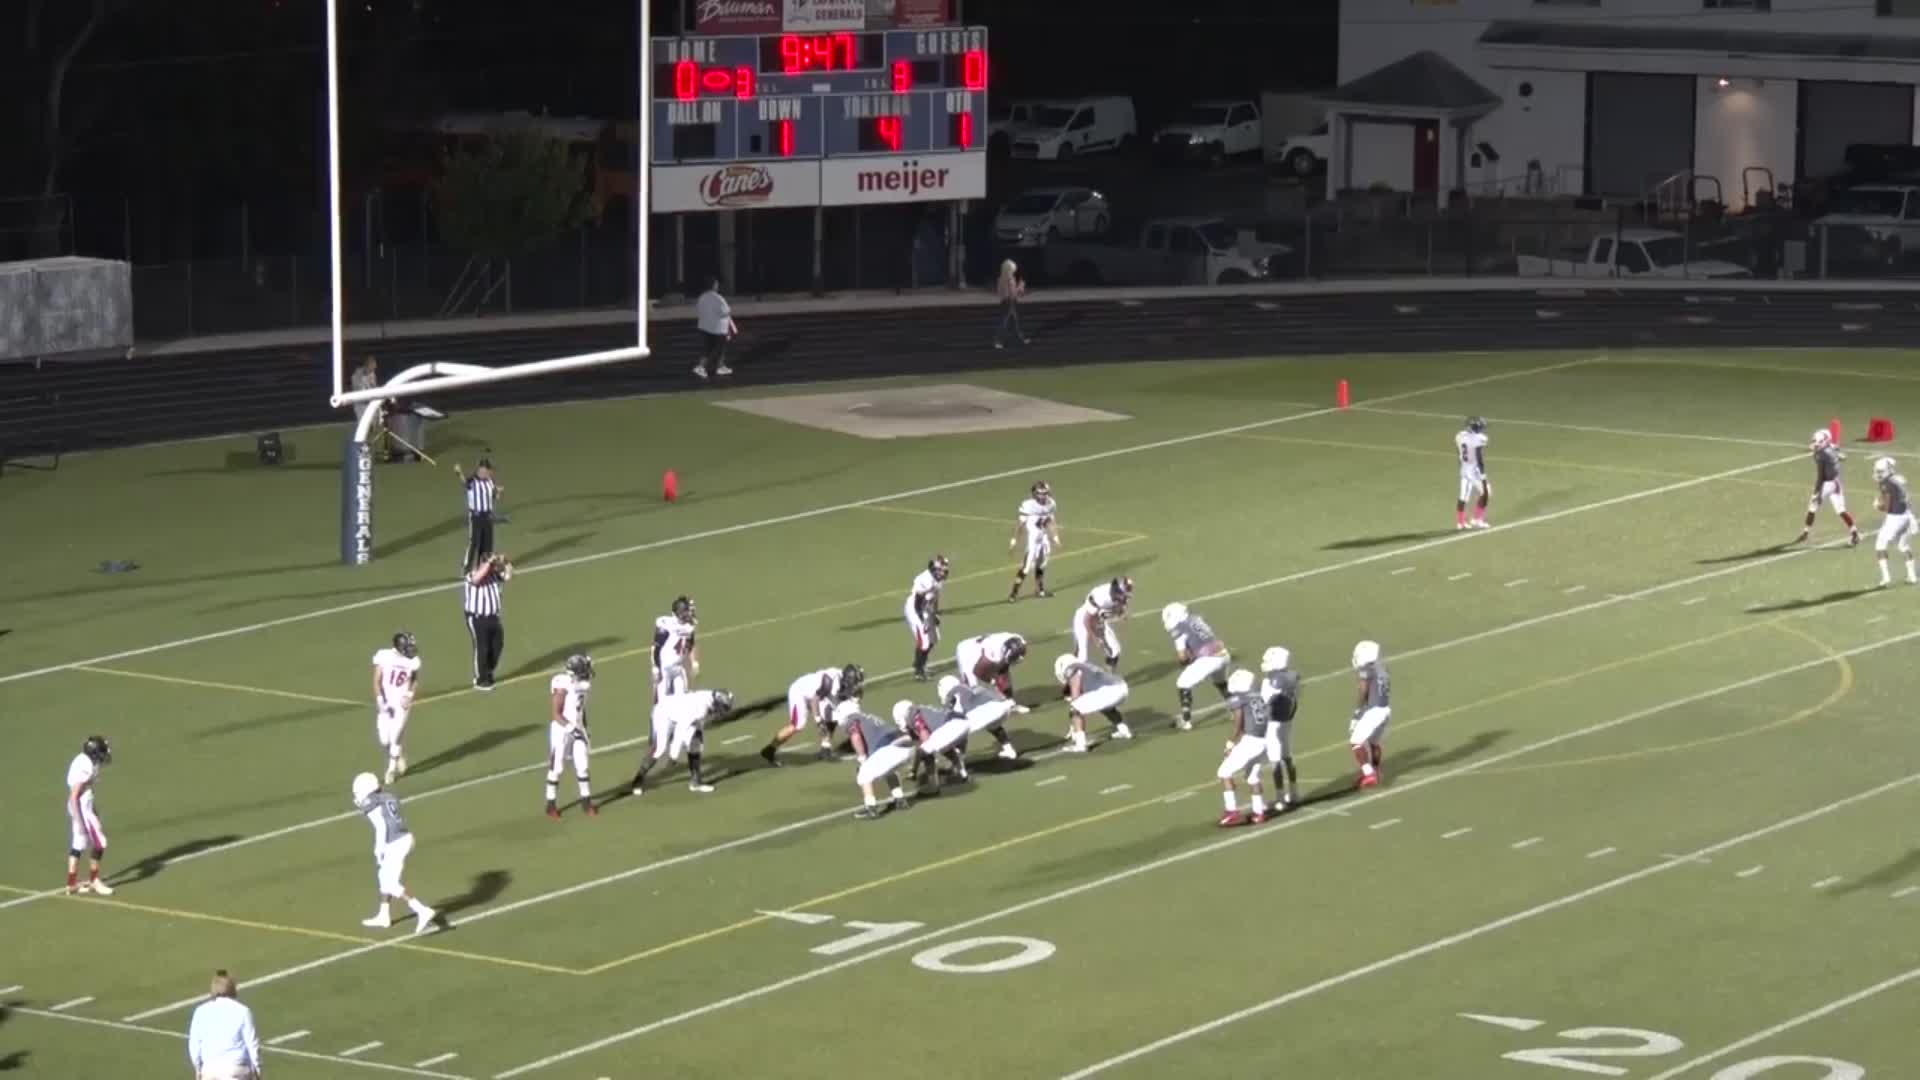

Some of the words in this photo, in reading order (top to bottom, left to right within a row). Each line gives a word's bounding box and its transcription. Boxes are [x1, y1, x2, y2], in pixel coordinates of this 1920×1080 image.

[669, 40, 717, 62] HOME
[782, 34, 855, 74] 9:47
[916, 32, 982, 55] GUESTS
[759, 98, 802, 120] DOWN
[878, 116, 901, 150] 4
[857, 160, 950, 195] meijer
[389, 669, 408, 687] 16
[809, 920, 1057, 973] 10
